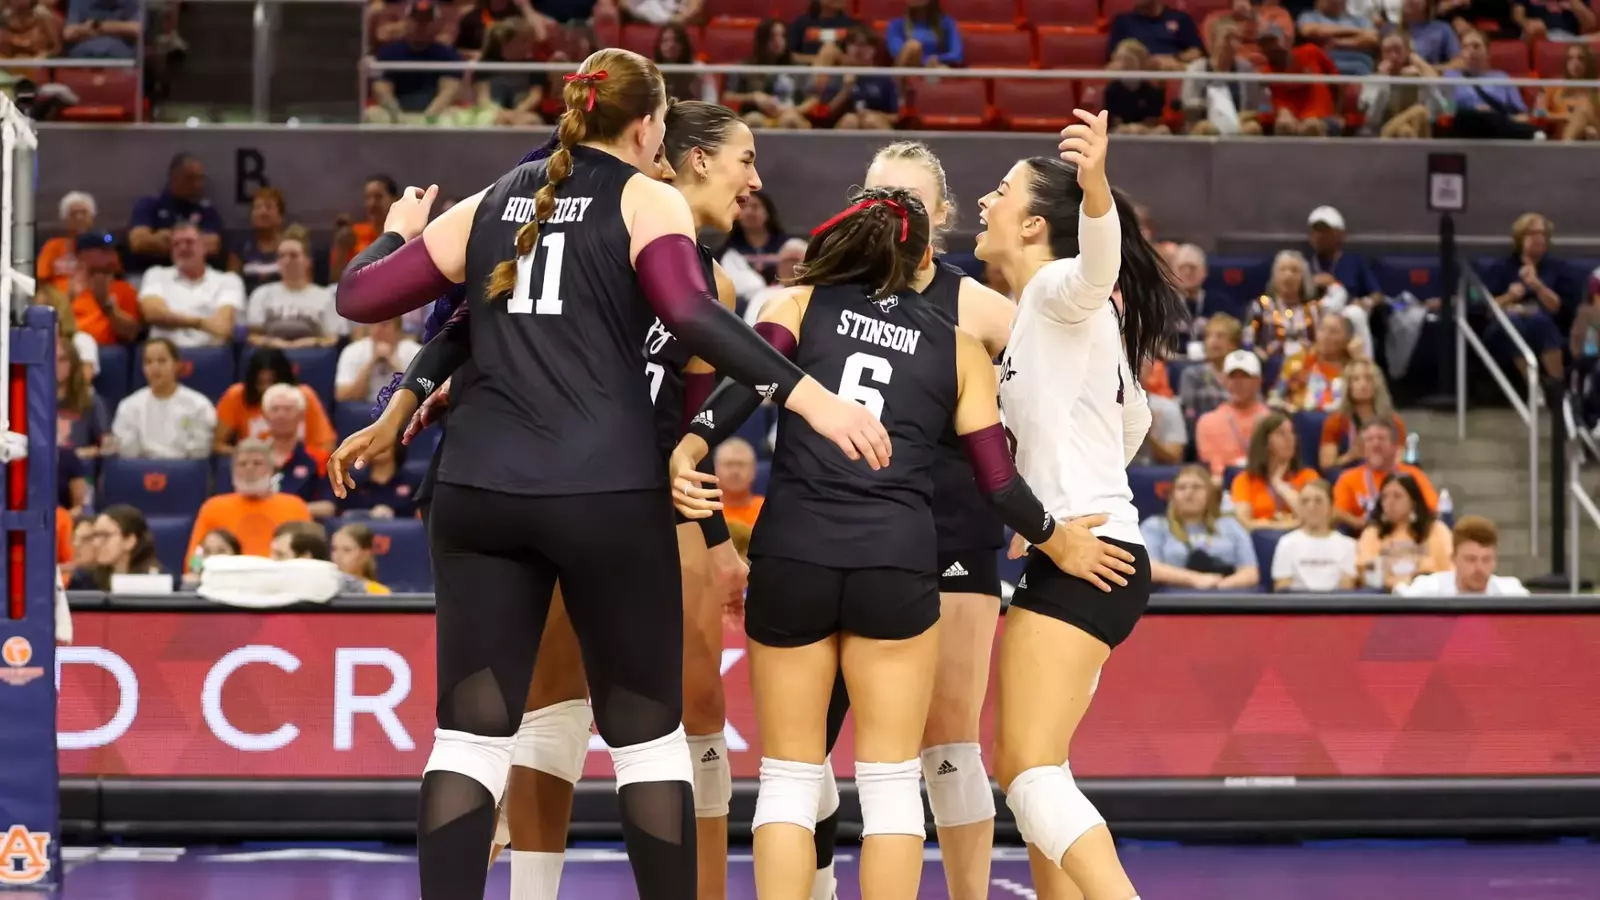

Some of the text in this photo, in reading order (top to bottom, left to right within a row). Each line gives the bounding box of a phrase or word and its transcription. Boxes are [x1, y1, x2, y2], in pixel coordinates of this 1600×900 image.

[237, 148, 269, 203] B
[507, 232, 565, 314] 11
[837, 309, 921, 356] STINSON
[838, 352, 894, 422] 6
